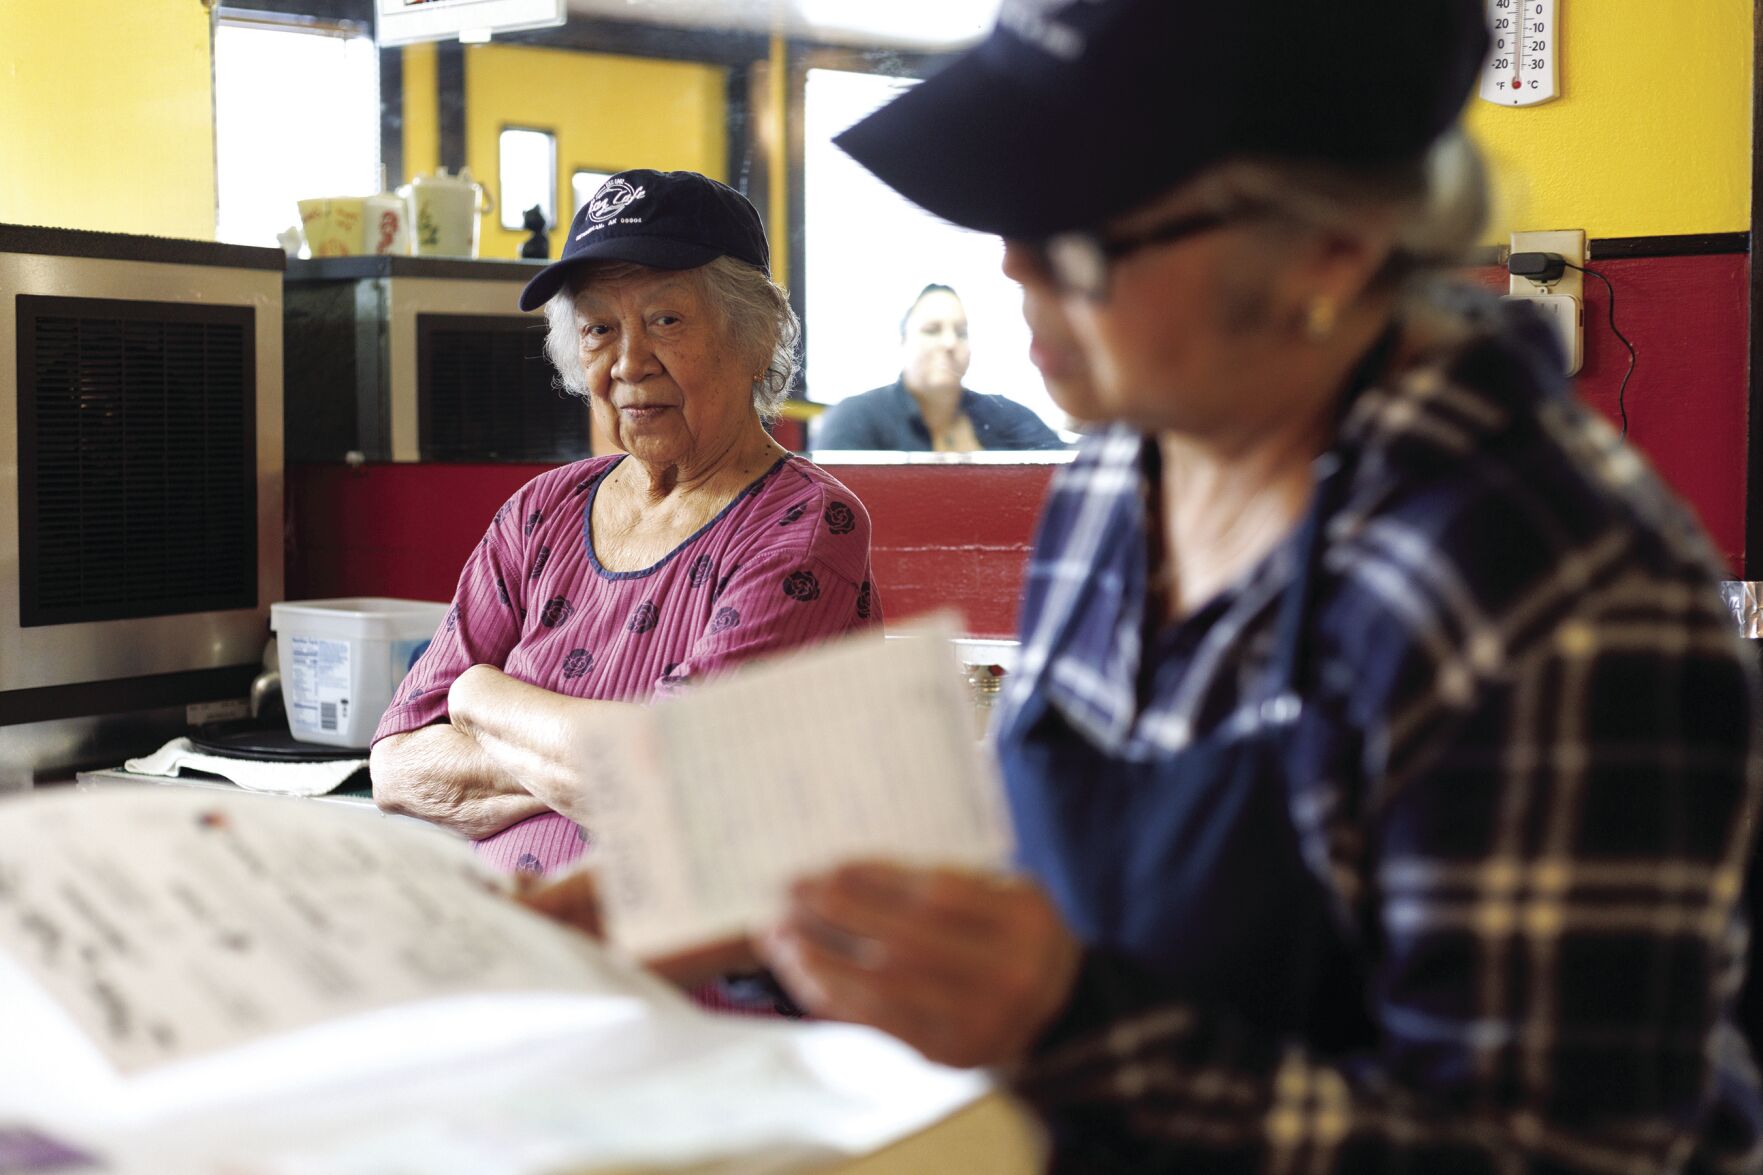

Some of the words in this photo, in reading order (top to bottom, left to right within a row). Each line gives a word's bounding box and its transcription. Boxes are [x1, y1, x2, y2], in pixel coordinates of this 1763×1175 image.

[1496, 0, 1510, 8] 40
[1536, 4, 1543, 15] 0
[1495, 18, 1509, 29] 20
[1529, 22, 1545, 33] -10
[1497, 39, 1505, 49] 0
[1528, 41, 1546, 51] -20
[1491, 59, 1508, 69] -20
[1528, 59, 1545, 70] -30
